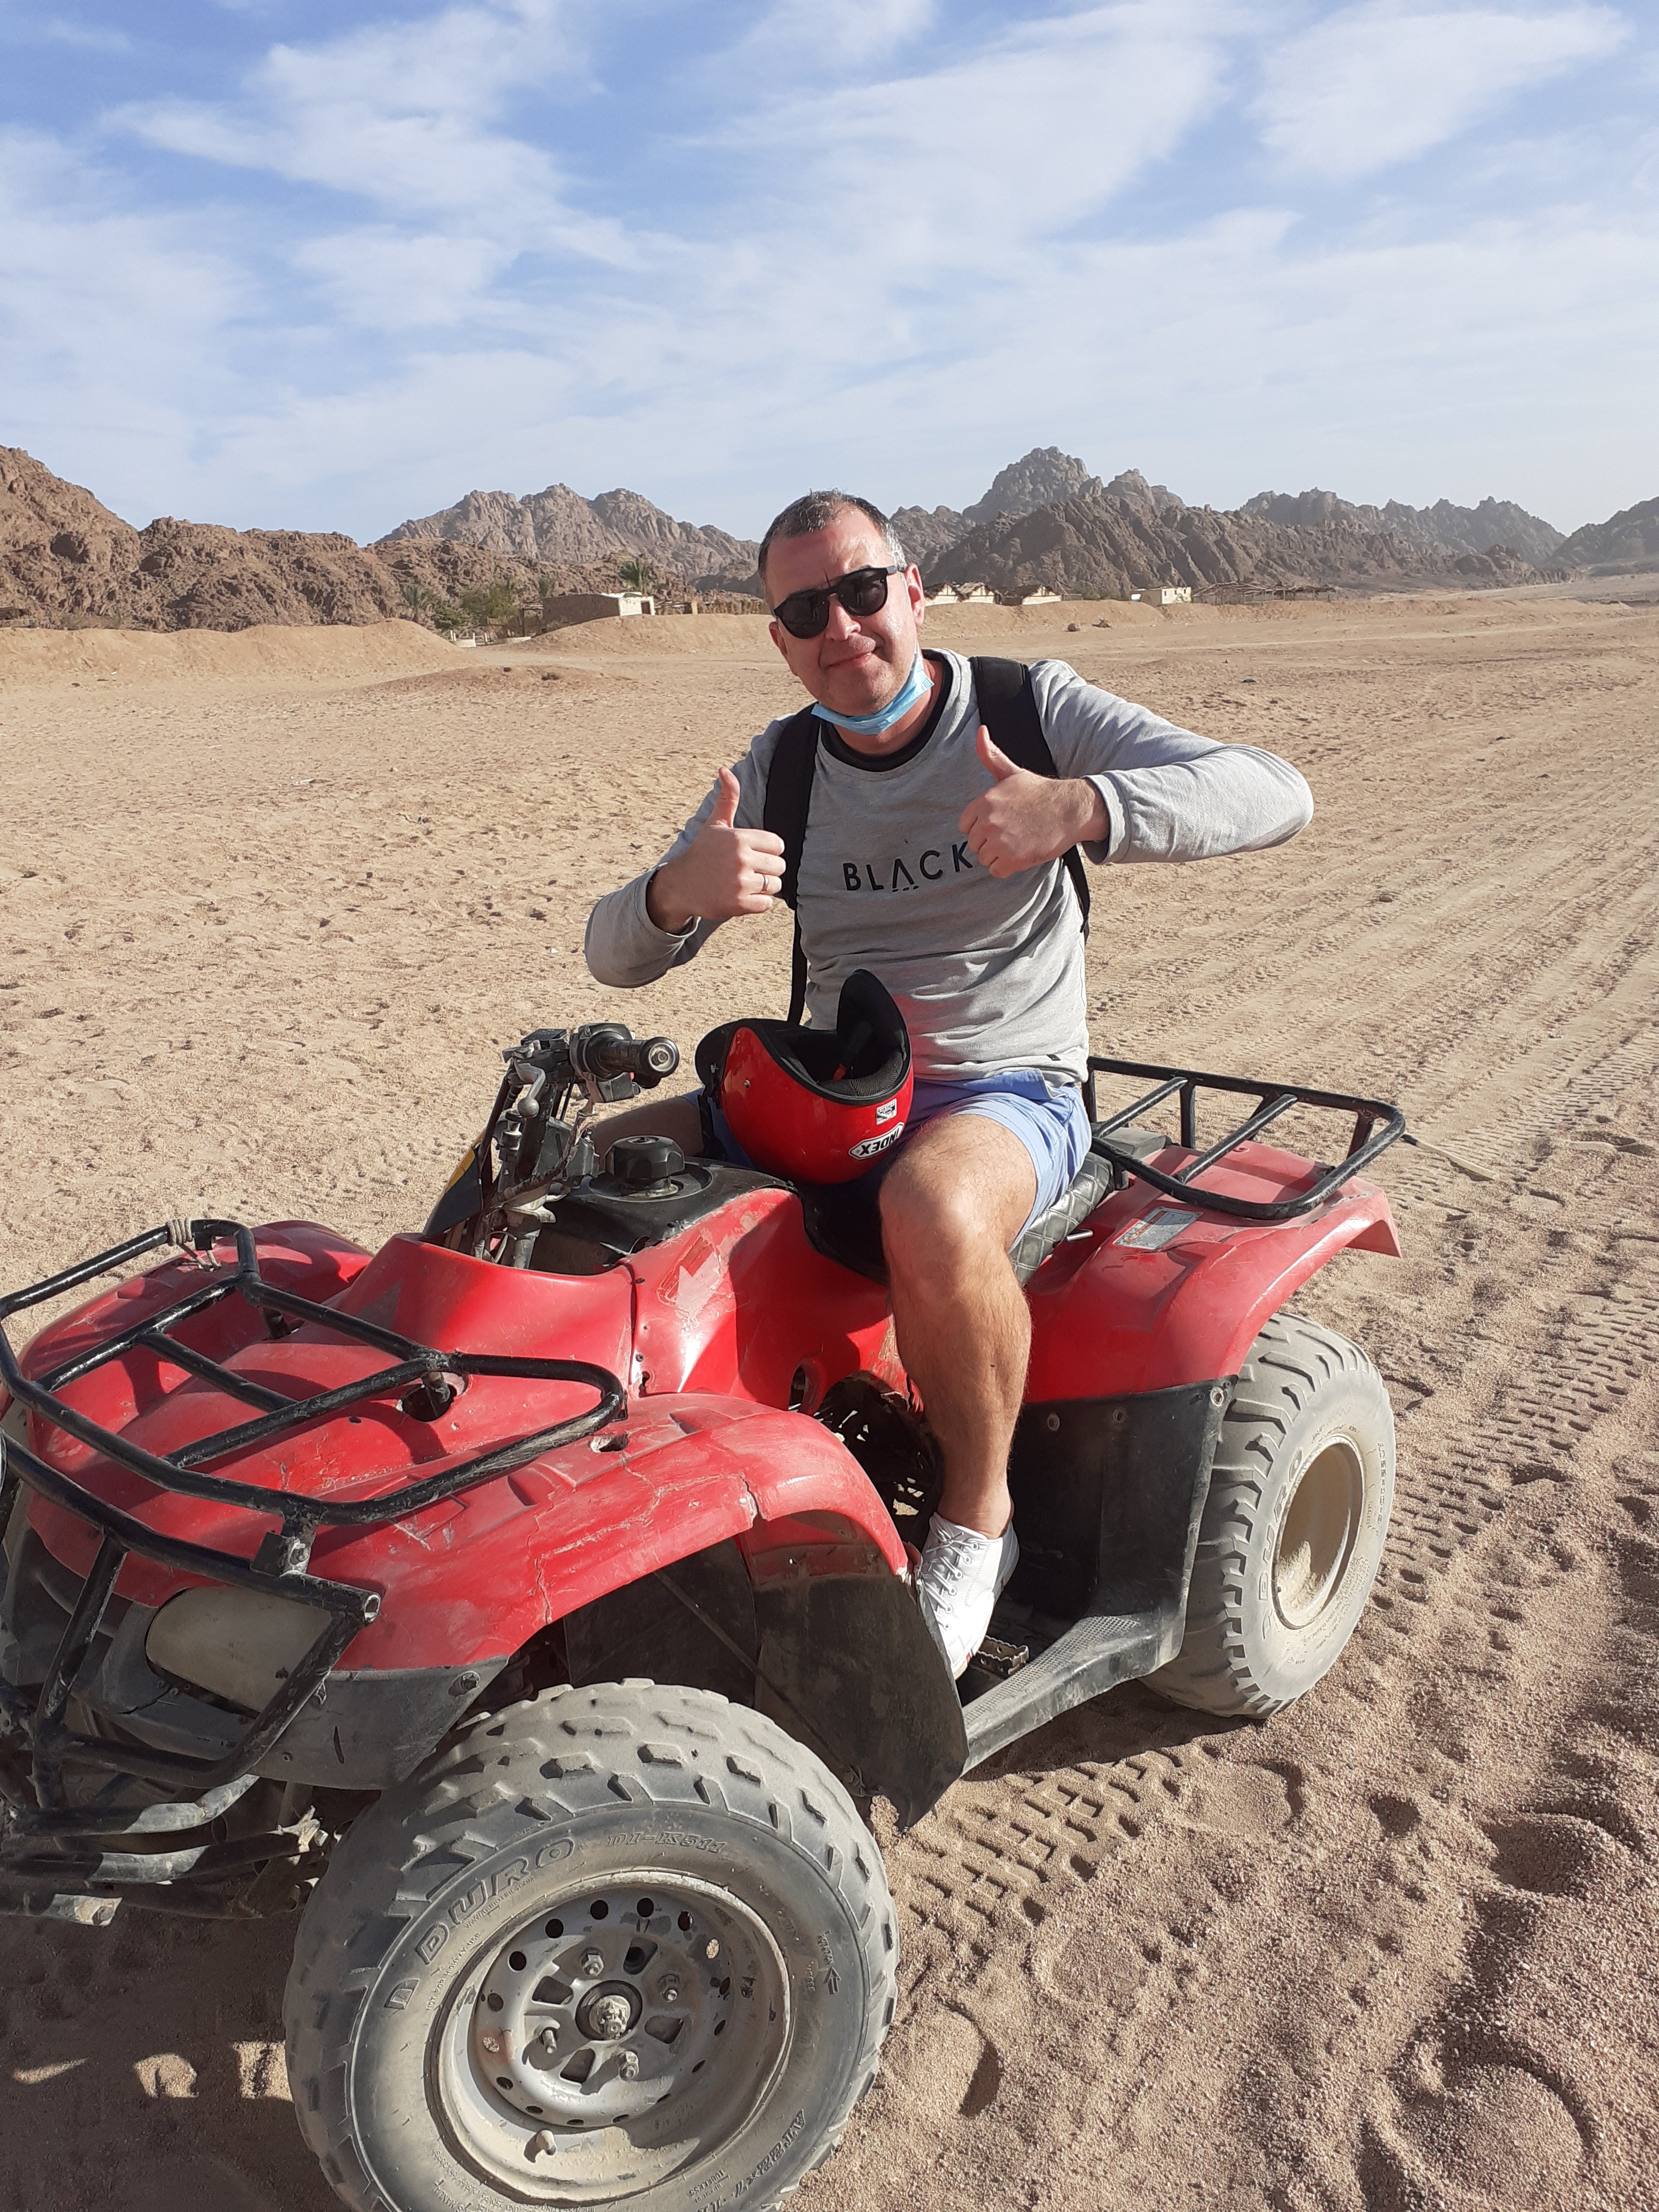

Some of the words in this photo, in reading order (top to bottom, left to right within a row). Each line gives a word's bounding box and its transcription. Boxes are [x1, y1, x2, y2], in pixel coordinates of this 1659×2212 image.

[843, 841, 973, 891] BLACK
[859, 1127, 899, 1156] INDEX
[414, 1837, 575, 1965] DURO
